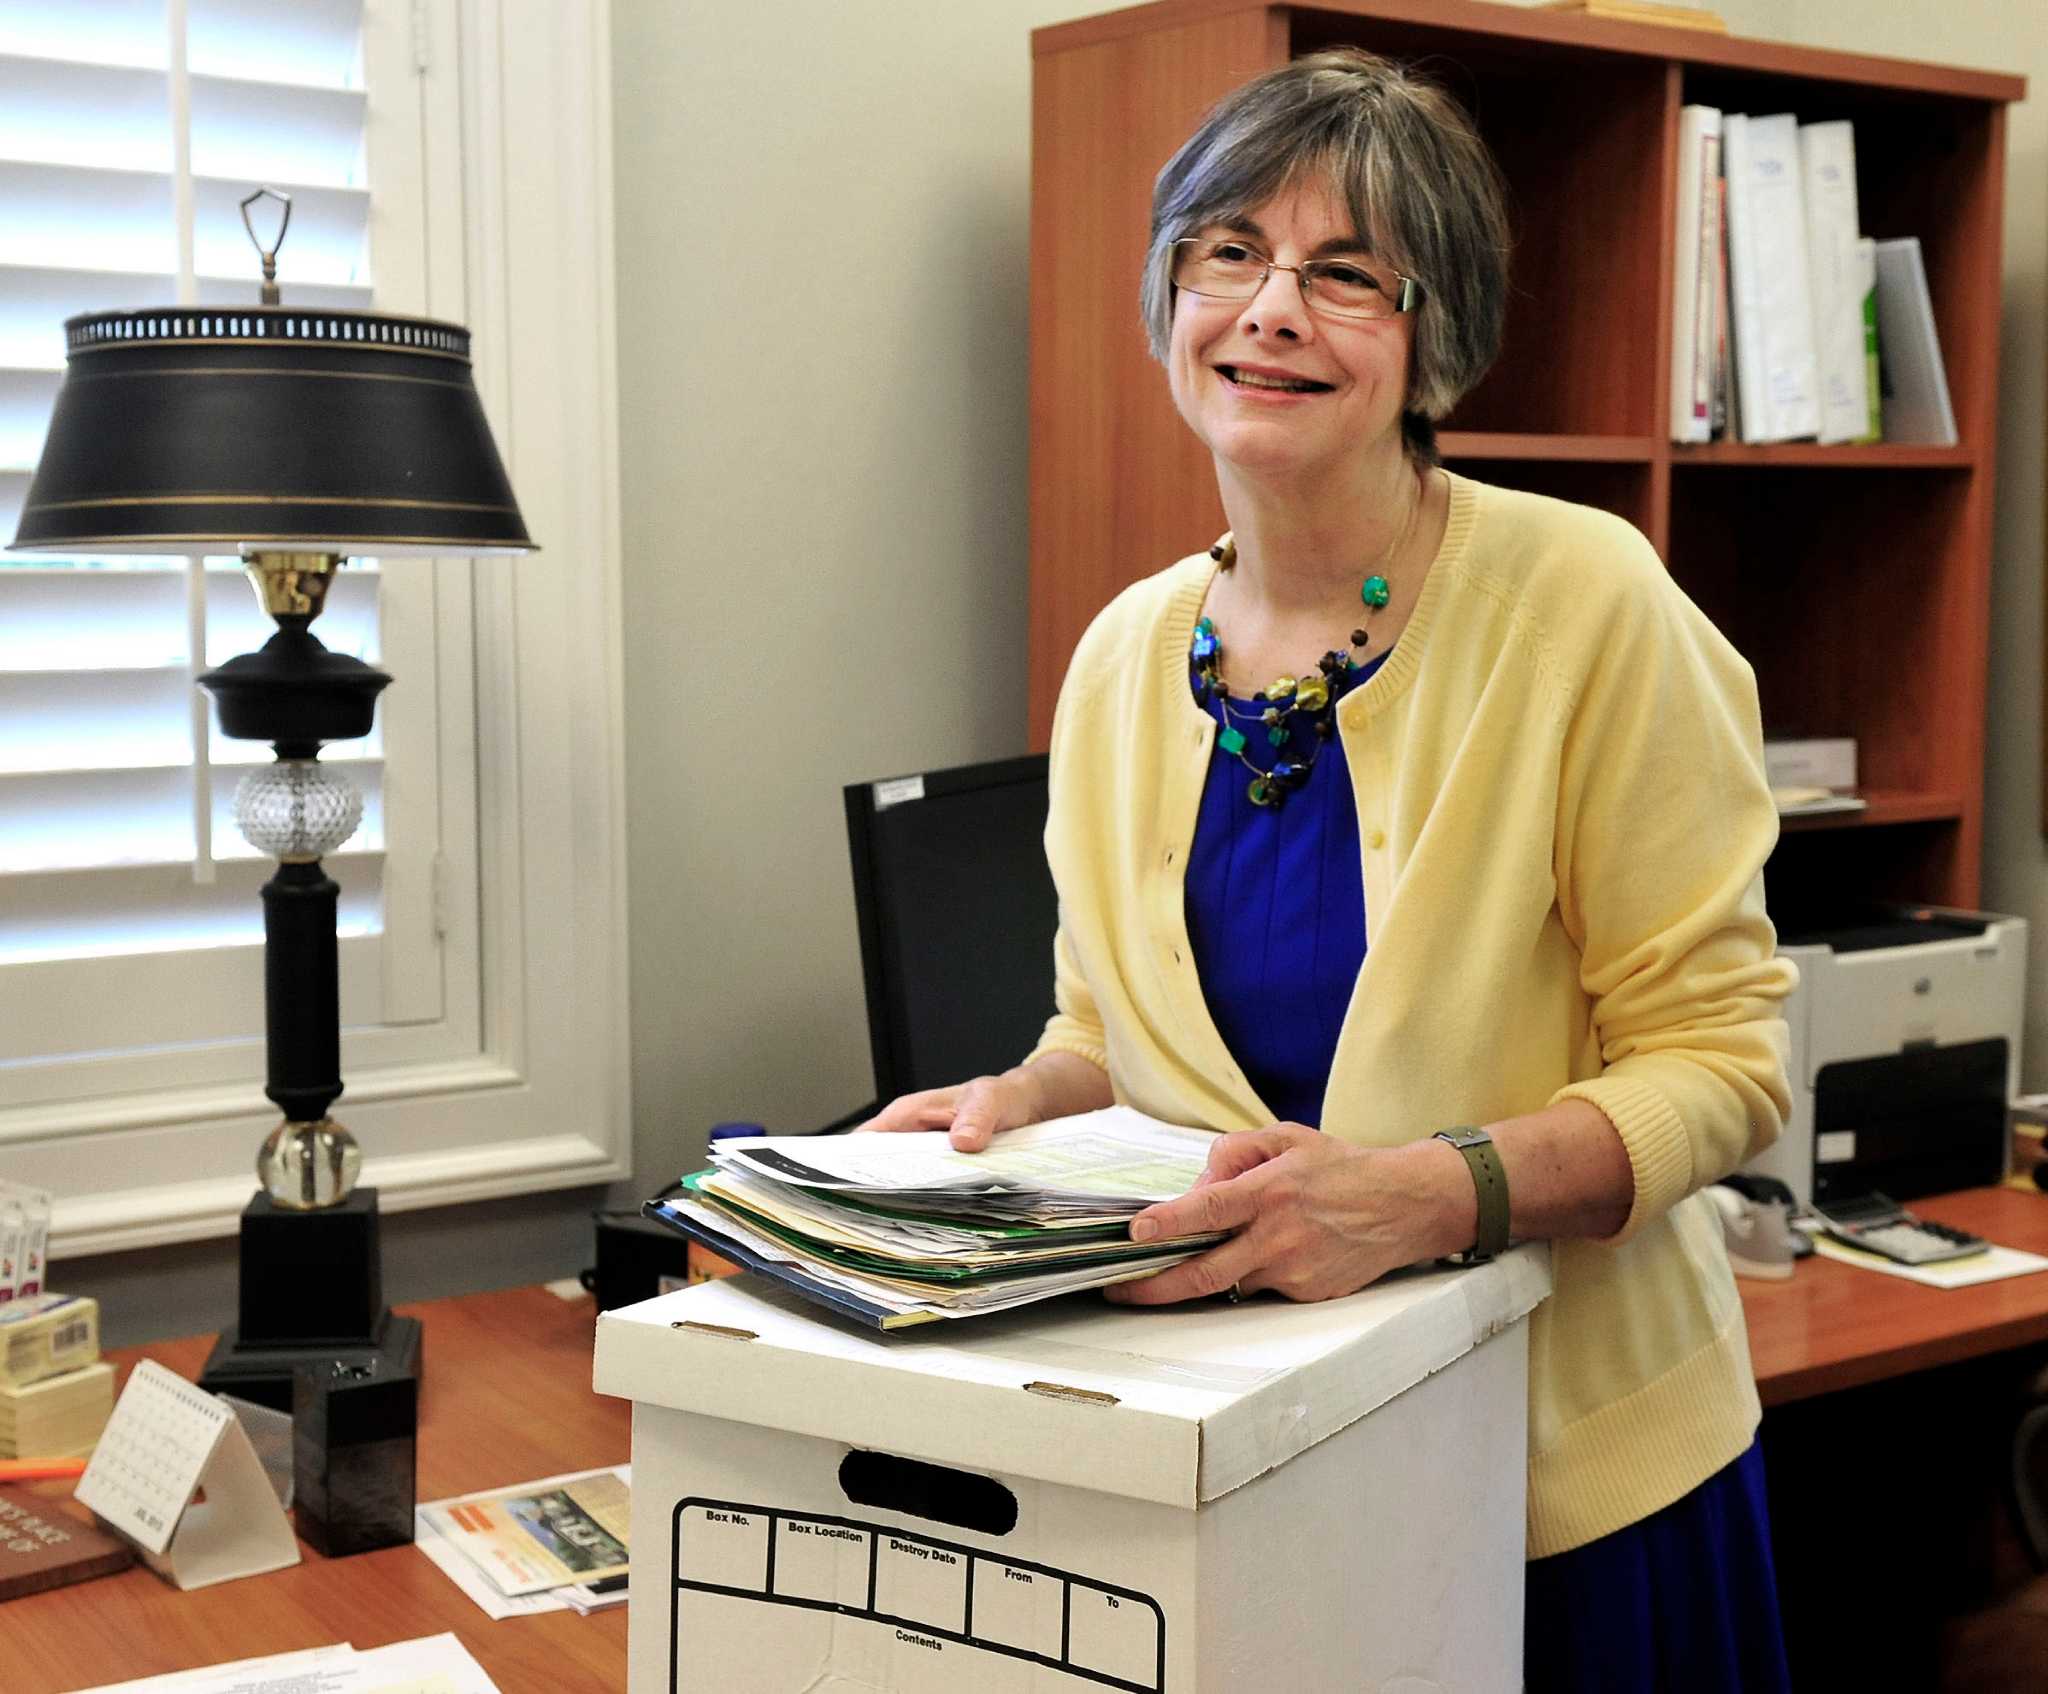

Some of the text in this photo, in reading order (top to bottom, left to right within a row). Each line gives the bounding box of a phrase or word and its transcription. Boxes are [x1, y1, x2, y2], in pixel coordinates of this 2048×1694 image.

[706, 1510, 750, 1526] Box No.
[788, 1521, 863, 1543] Box Location
[890, 1539, 957, 1565] Destroy Date
[1004, 1567, 1033, 1584] From
[1105, 1595, 1120, 1609] To
[895, 1629, 943, 1651] Contents
